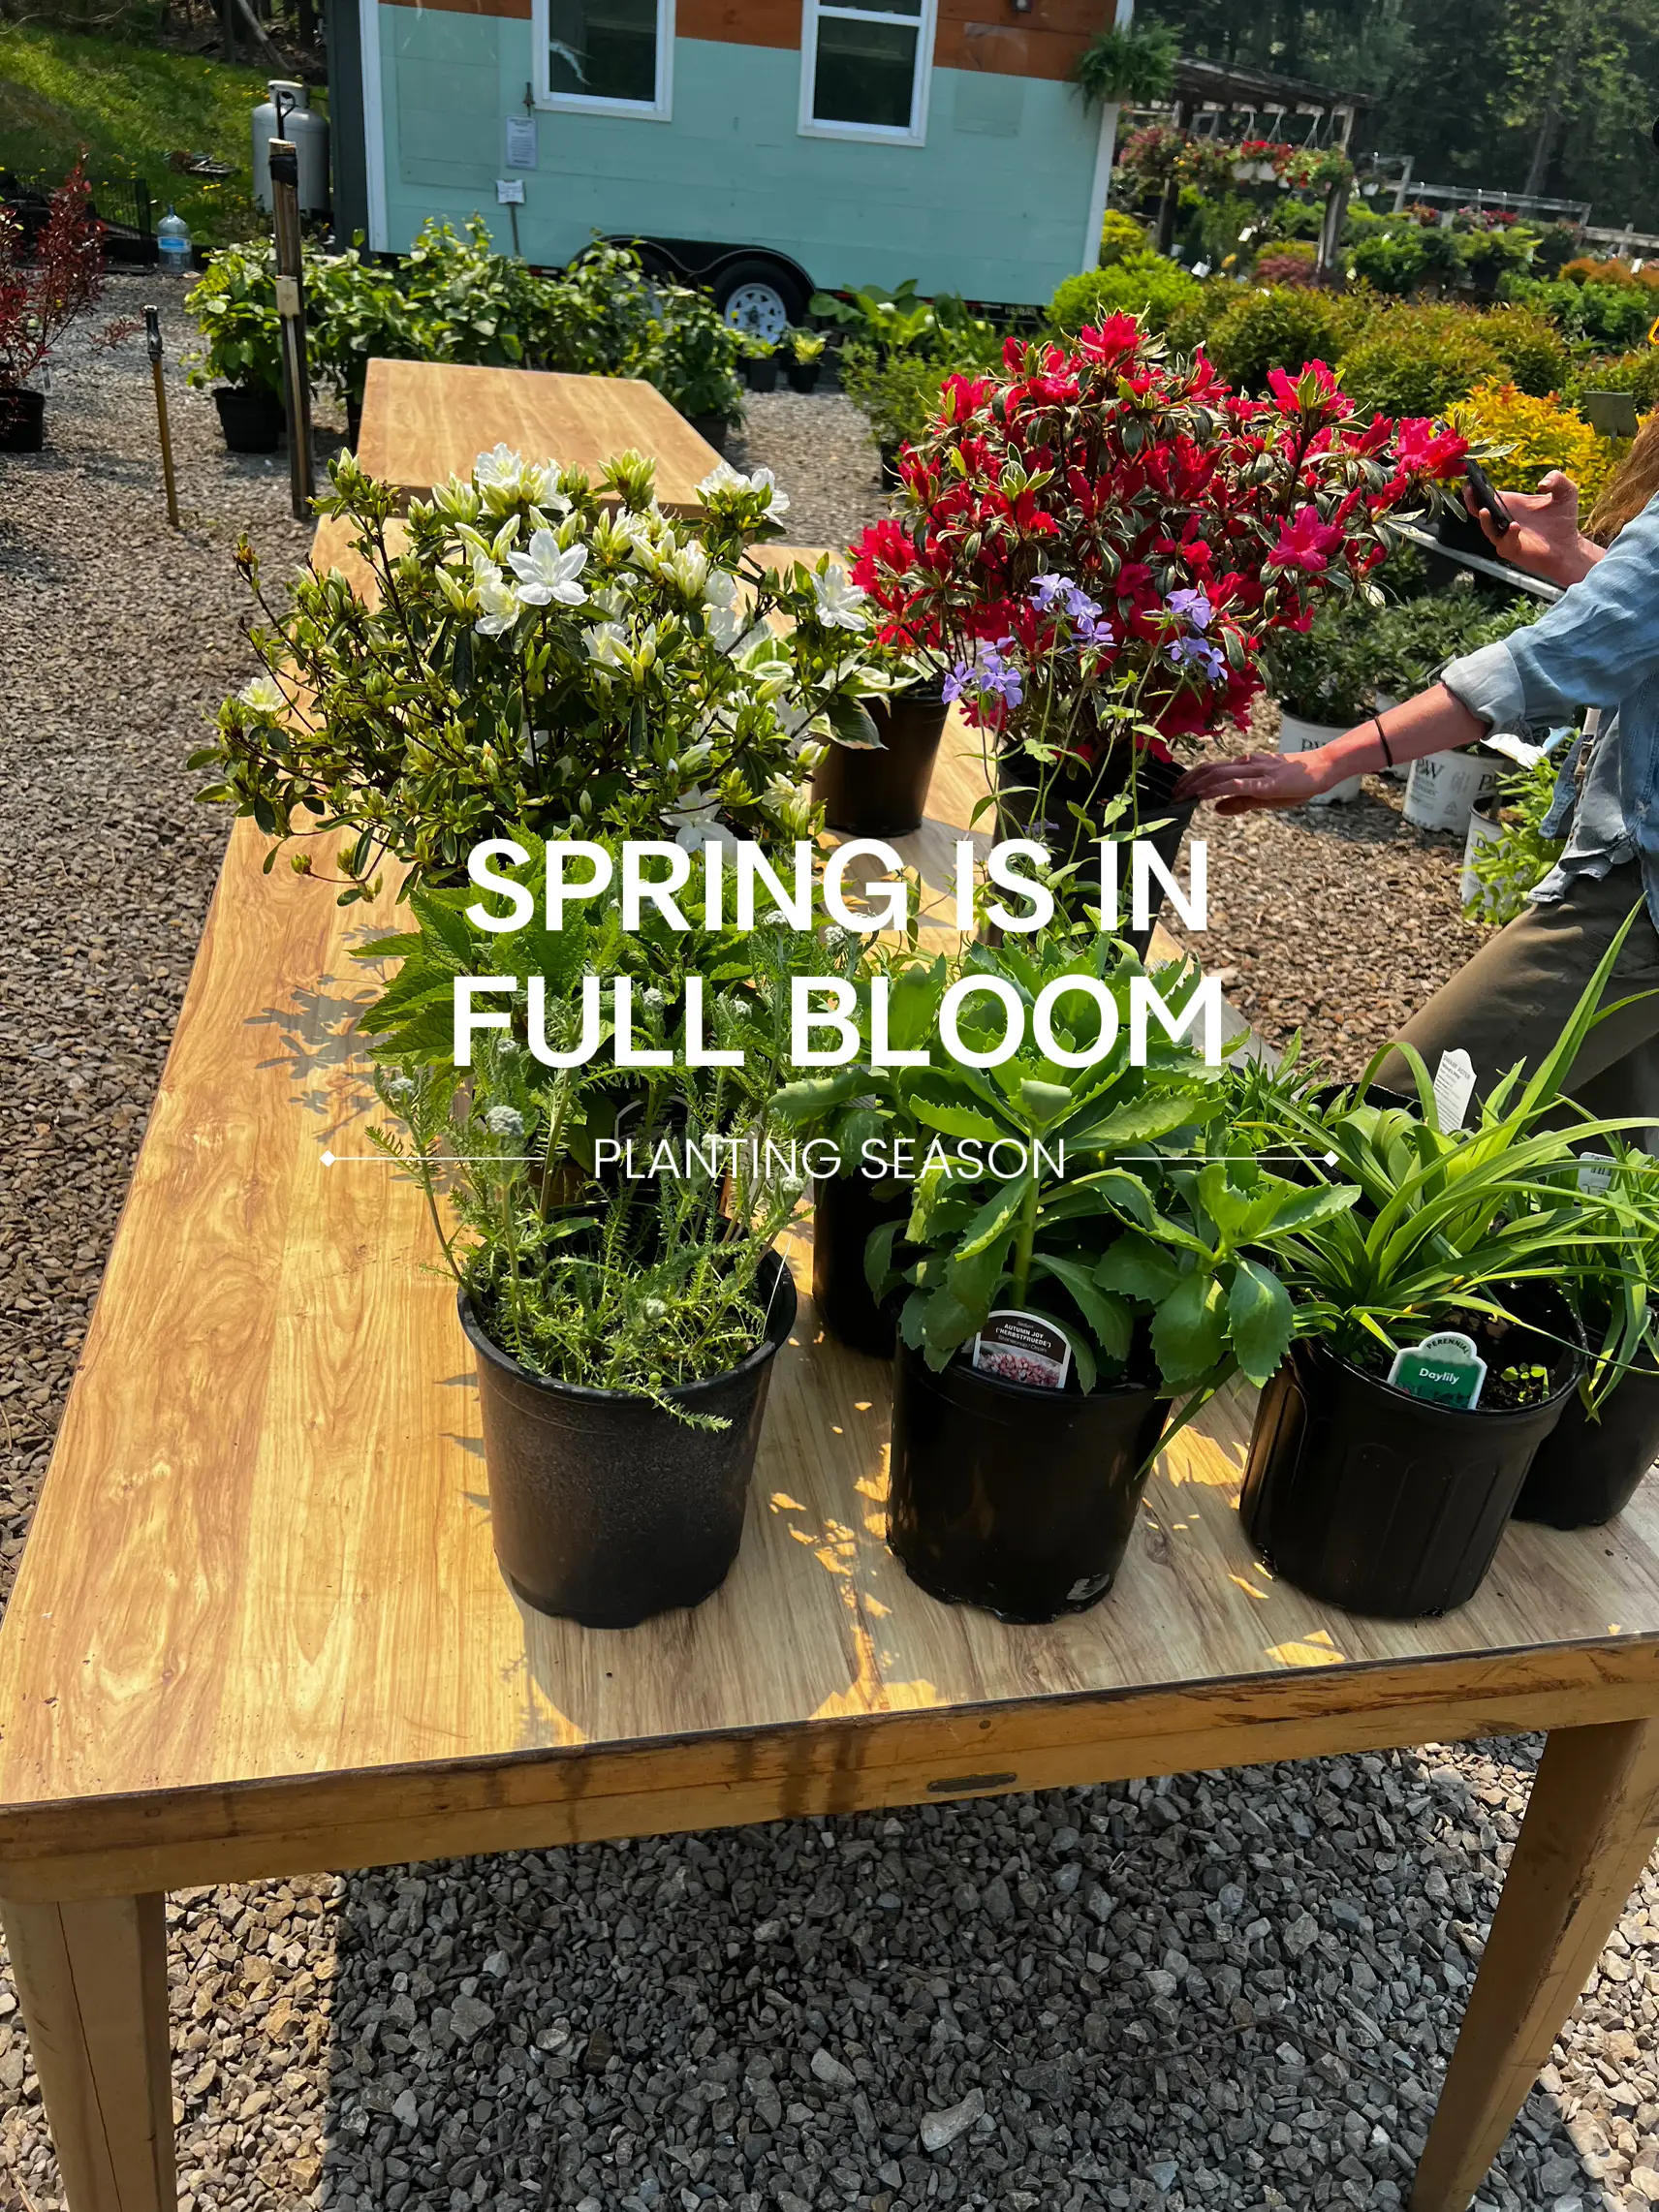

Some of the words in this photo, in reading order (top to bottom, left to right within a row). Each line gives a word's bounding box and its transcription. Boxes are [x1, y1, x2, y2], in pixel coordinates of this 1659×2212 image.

[1004, 1324, 1030, 1335] AUTUMN
[1425, 1338, 1469, 1355] PERENNIAL
[1419, 1367, 1460, 1385] Daylily
